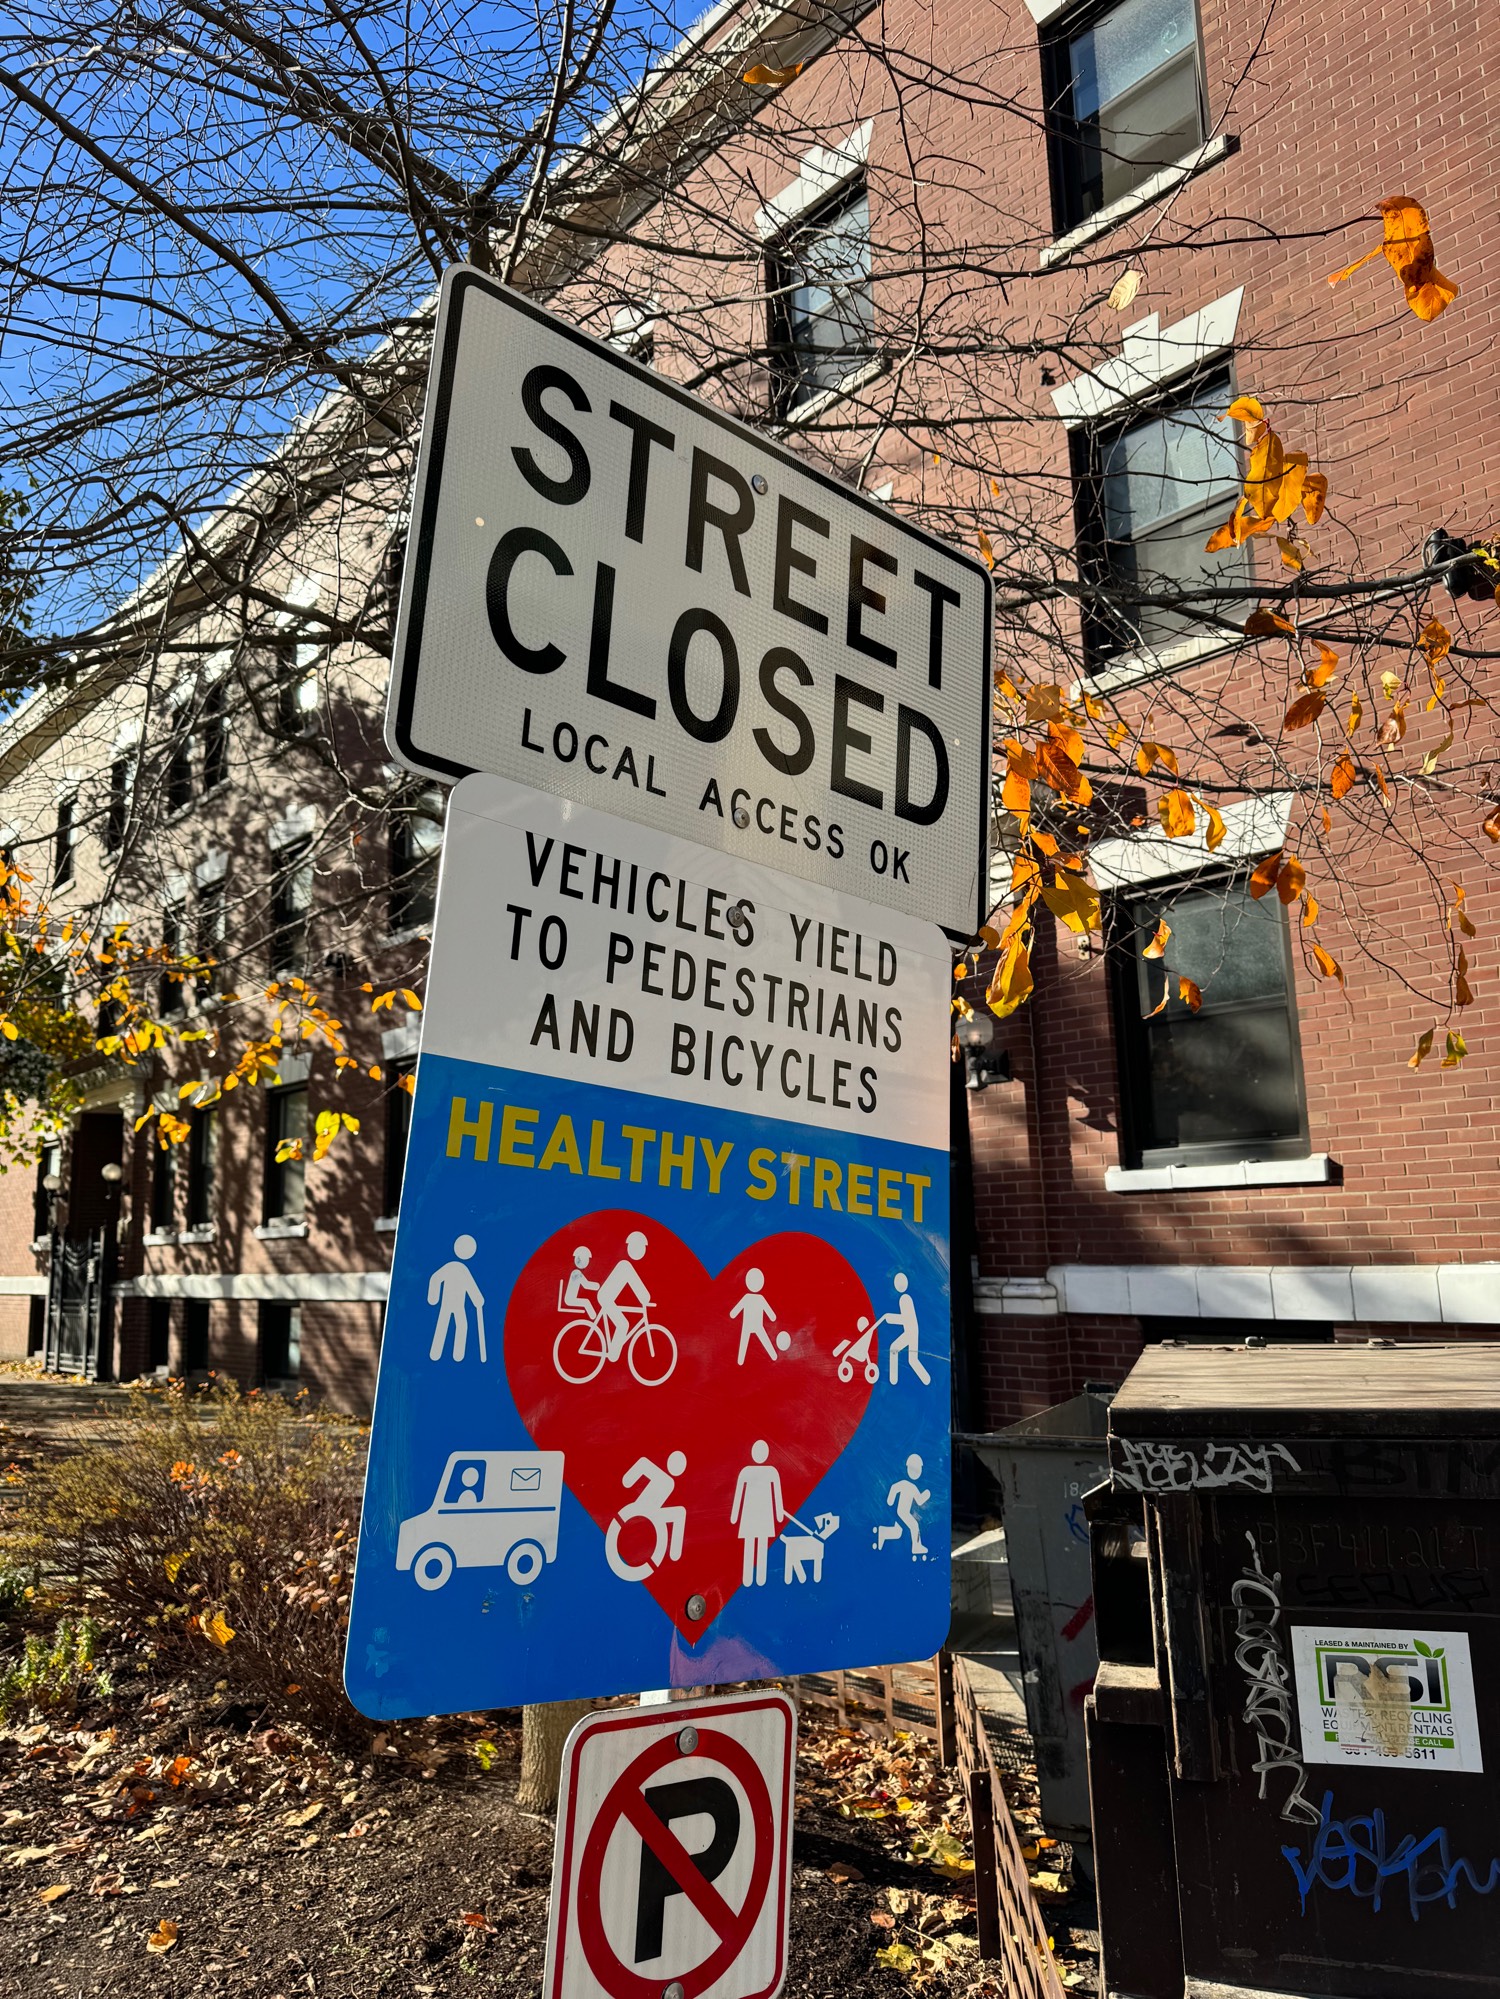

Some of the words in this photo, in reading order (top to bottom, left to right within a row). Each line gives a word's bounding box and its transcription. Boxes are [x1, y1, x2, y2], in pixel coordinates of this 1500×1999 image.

[511, 364, 961, 691] STREET
[486, 526, 950, 826] CLOSED
[521, 708, 666, 797] LOCAL
[699, 778, 844, 859] ACCESS
[869, 839, 911, 884] OK
[525, 831, 756, 947] VEHICLES
[790, 913, 897, 987] YIELD
[506, 904, 567, 970] TO
[606, 933, 902, 1053] PEDESTRIANS
[530, 993, 633, 1063] AND
[671, 1023, 878, 1113] BICYCLES
[445, 1096, 735, 1194] HEALTHY
[746, 1148, 931, 1223] STREET
[1325, 1655, 1442, 1704] RSI
[1351, 1641, 1396, 1649] MAINTAINED
[1380, 1710, 1452, 1724] RECYCLING
[1395, 1722, 1454, 1736] RENTALS
[1422, 1738, 1443, 1746] CALL
[634, 1776, 740, 1964] P
